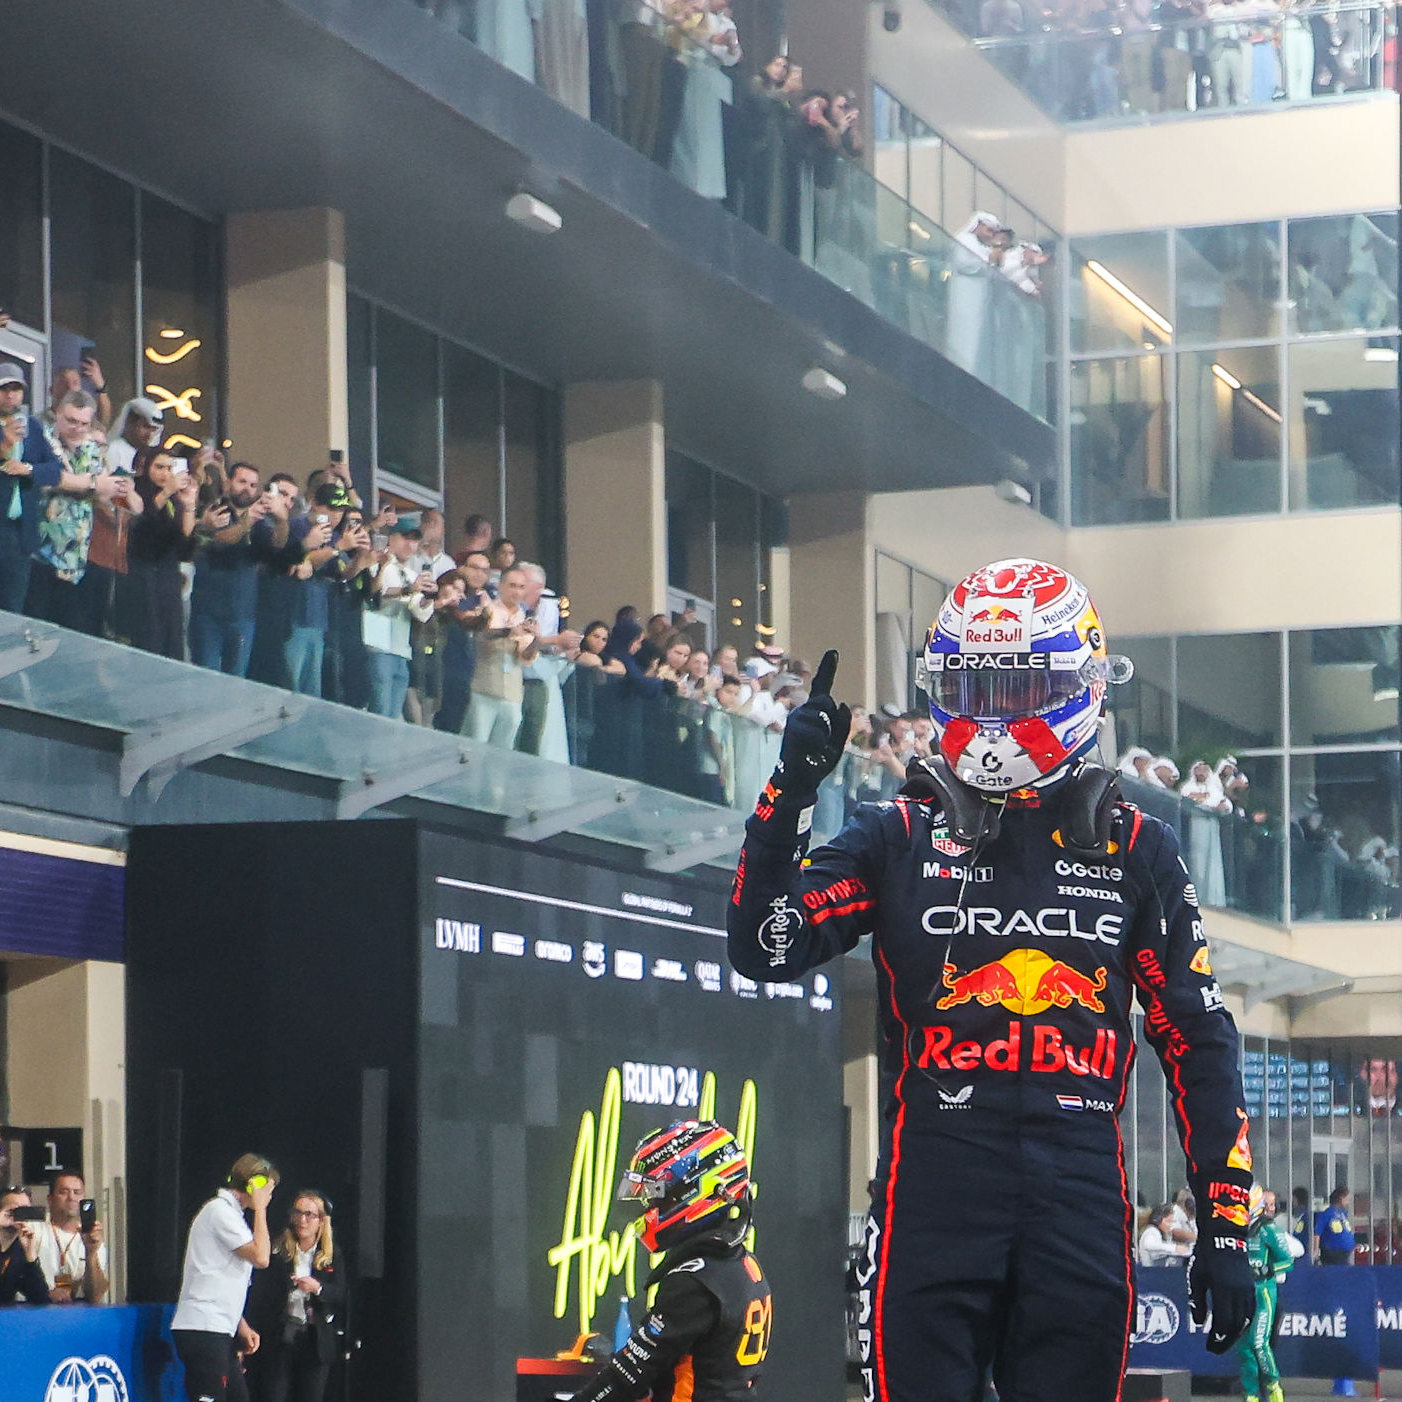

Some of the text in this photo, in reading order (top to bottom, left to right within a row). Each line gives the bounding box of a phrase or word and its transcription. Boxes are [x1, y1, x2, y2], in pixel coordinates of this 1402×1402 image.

[1041, 596, 1080, 626] Heineken
[965, 628, 1022, 643] Red Bull
[946, 653, 1046, 670] ORACLE
[922, 861, 974, 882] Mobil
[1072, 863, 1123, 882] Gate
[1057, 885, 1124, 904] HONDA
[435, 917, 482, 954] LVMH
[769, 894, 789, 968] Hard Rock
[921, 905, 1124, 946] ORACLE
[917, 1020, 1117, 1079] Red Bull
[622, 1061, 699, 1107] ROUND 24
[1085, 1099, 1116, 1113] MAX
[44, 1141, 64, 1171] 1
[736, 1294, 772, 1366] 81
[1278, 1308, 1347, 1338] ERMÉ
